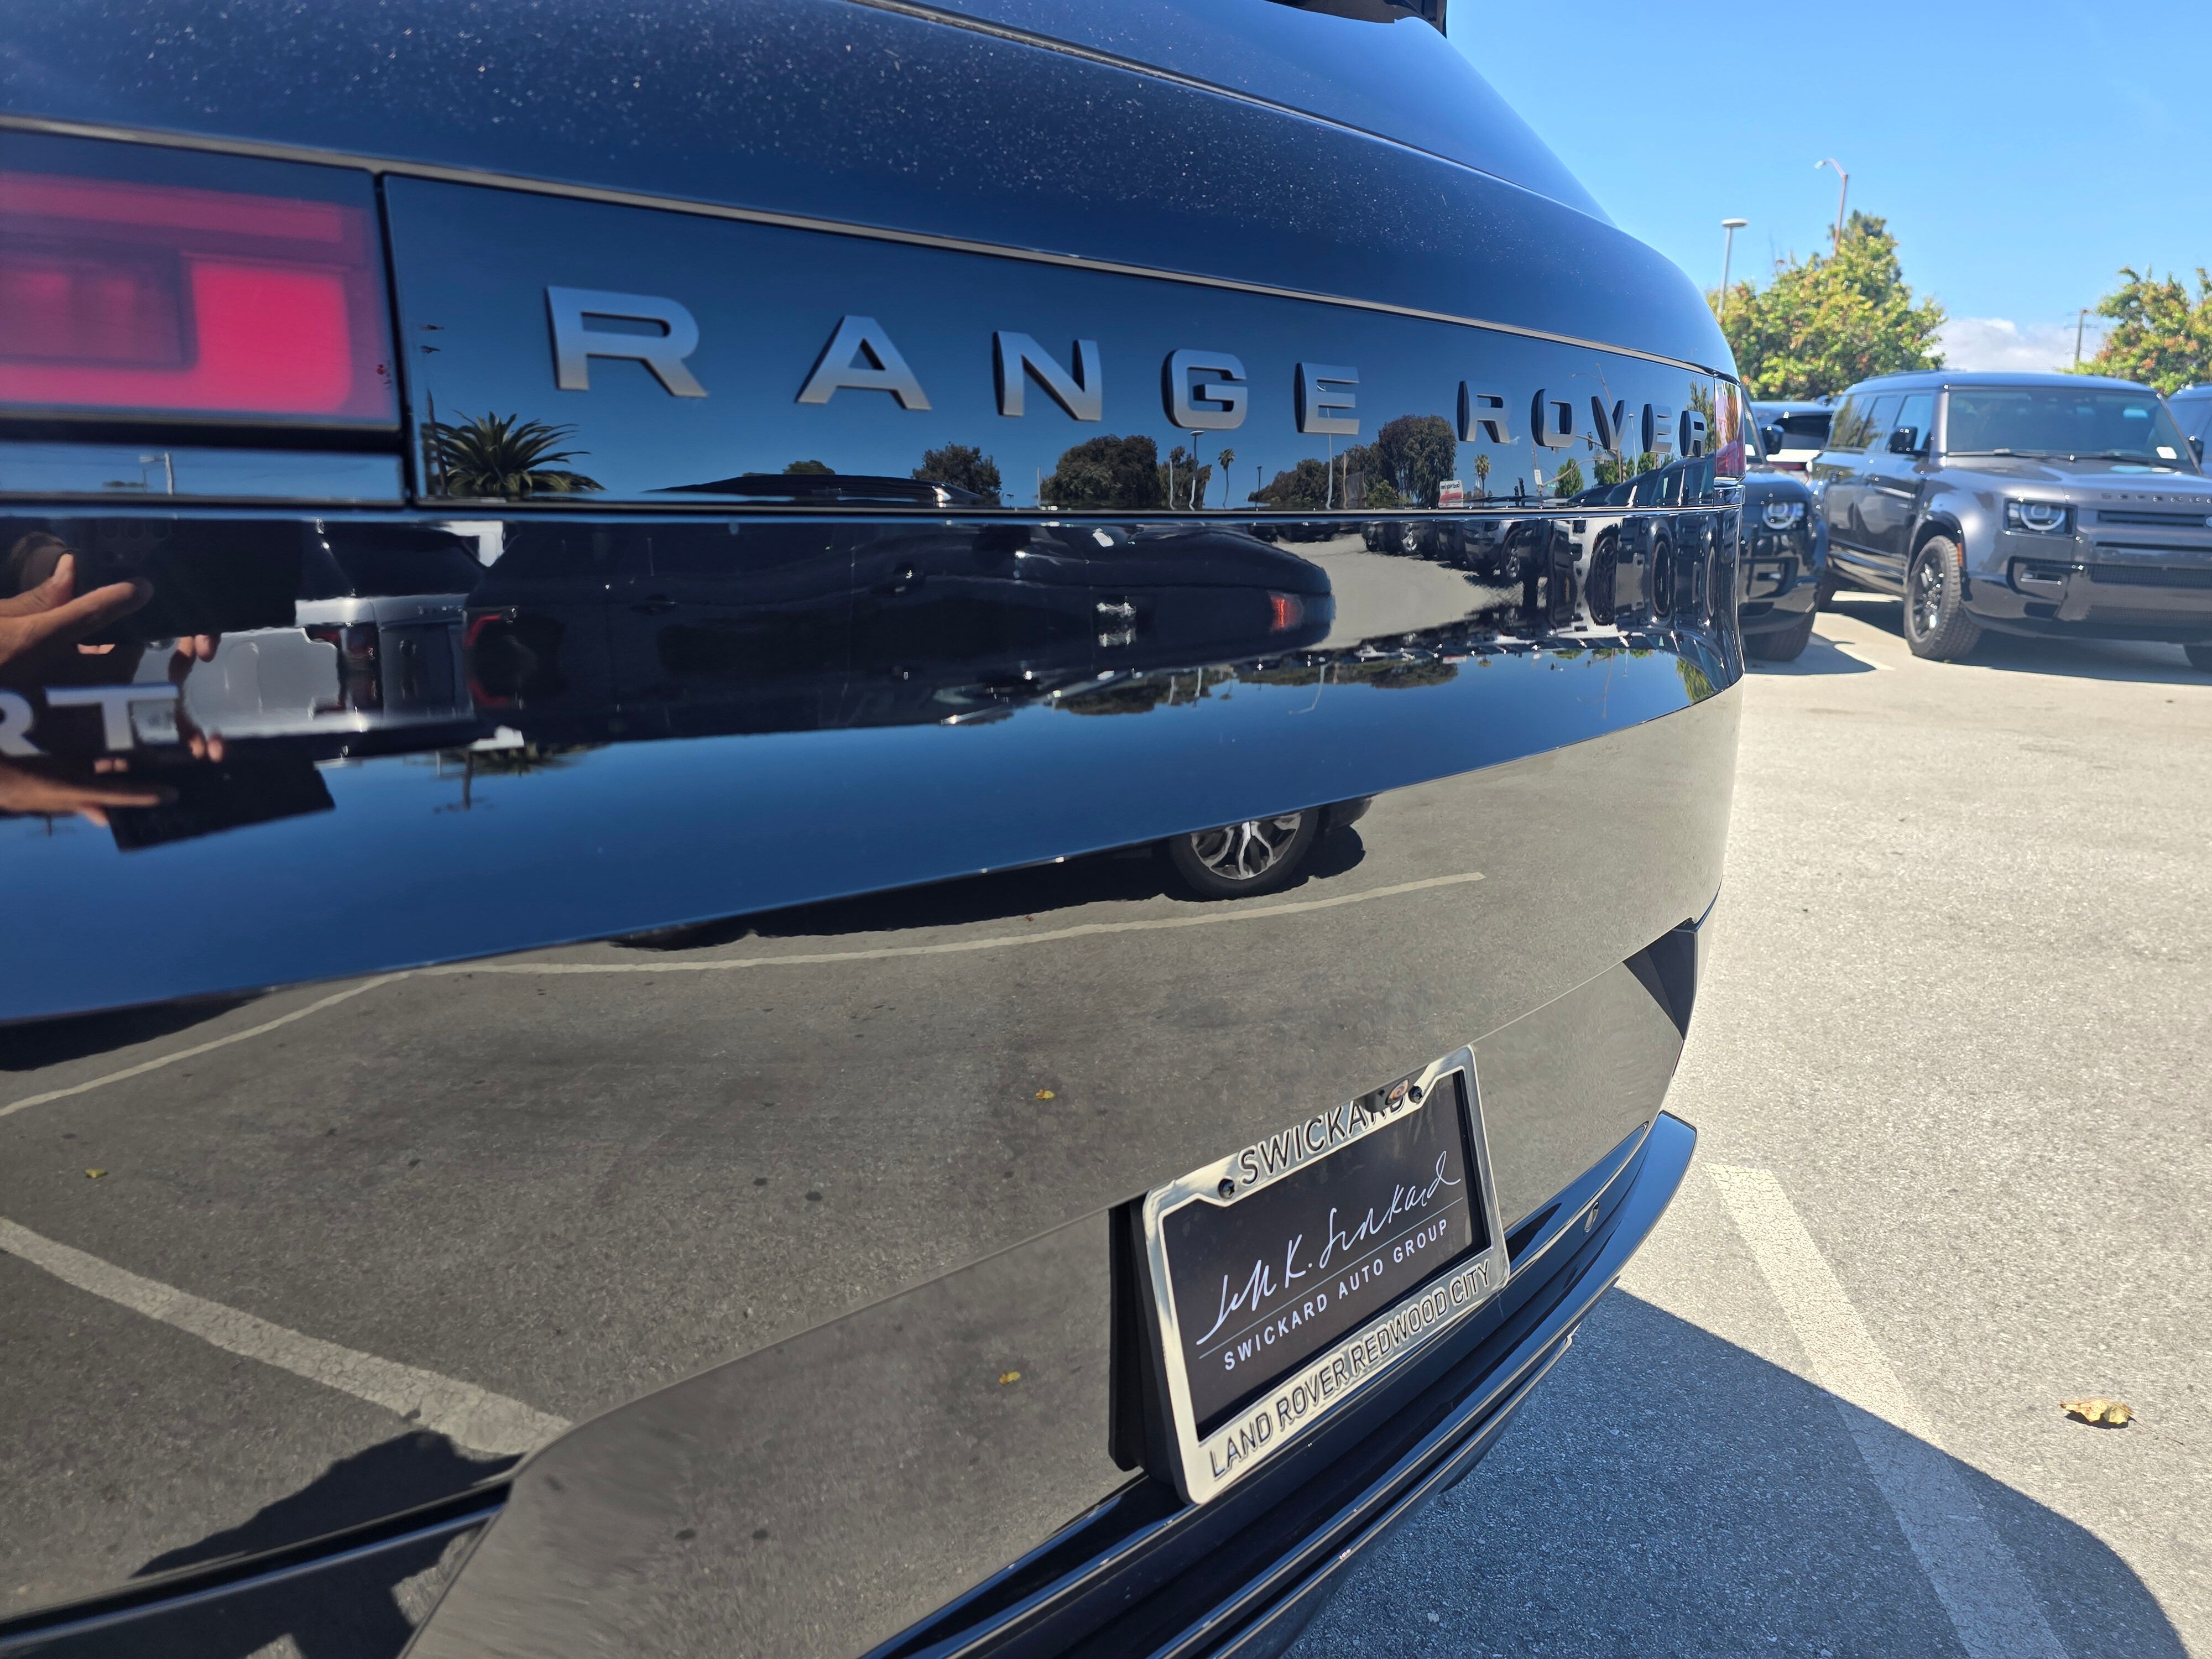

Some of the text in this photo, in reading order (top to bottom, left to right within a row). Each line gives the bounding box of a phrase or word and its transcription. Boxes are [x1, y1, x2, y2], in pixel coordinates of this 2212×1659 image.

[544, 285, 1707, 458] RANGE ROVER
[1240, 1095, 1405, 1185] SWICKA
[1209, 1260, 1490, 1478] LAND ROVER REDWOOD CITY
[1224, 1219, 1447, 1371] SWICKARD AUTO GROUP
